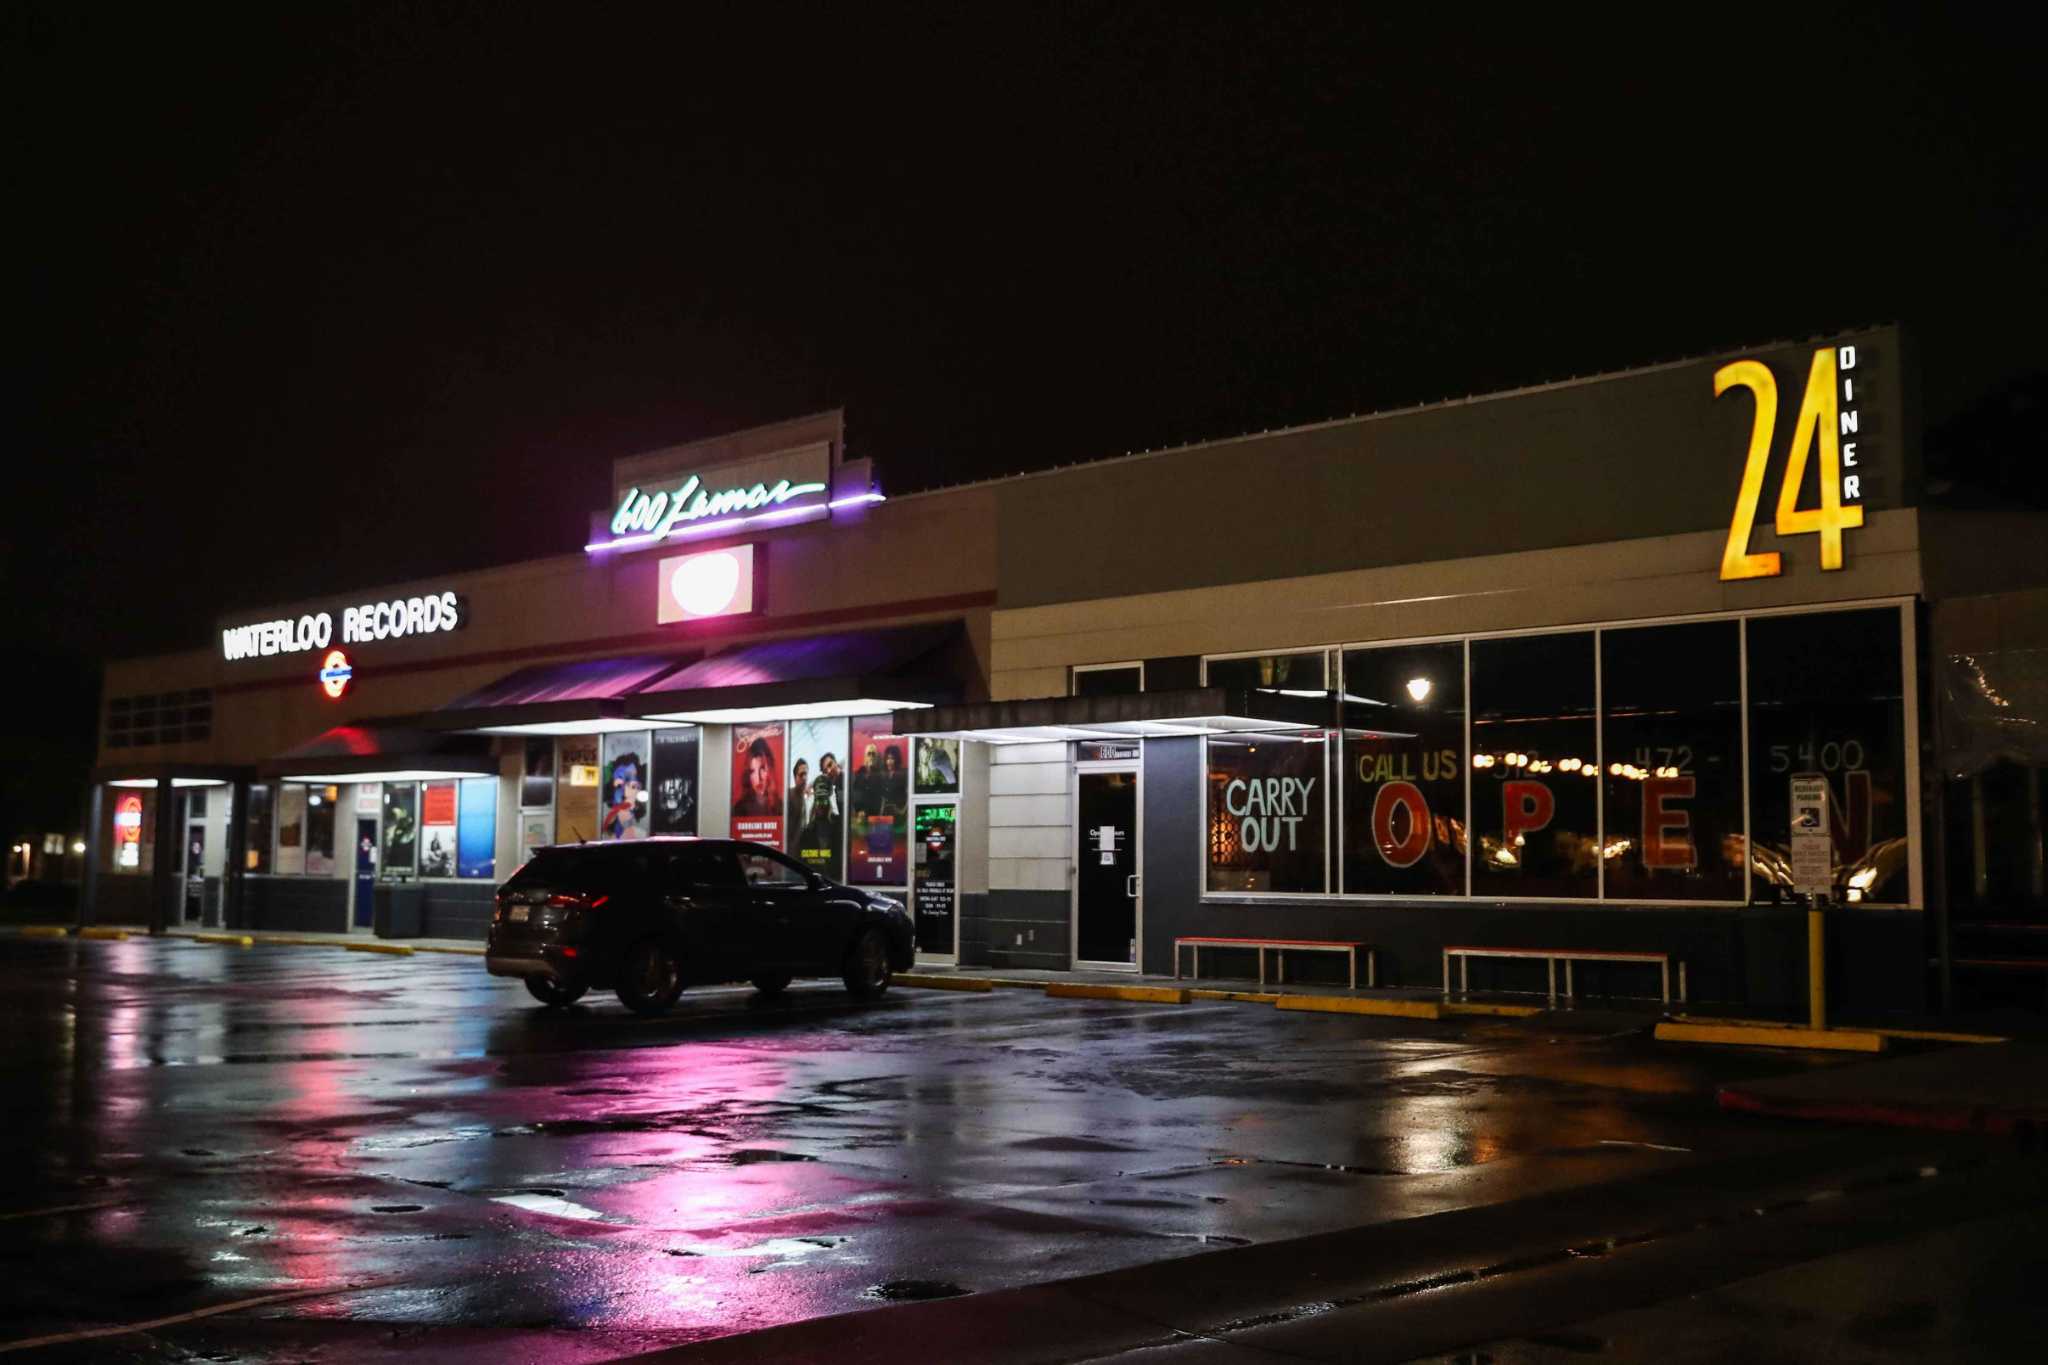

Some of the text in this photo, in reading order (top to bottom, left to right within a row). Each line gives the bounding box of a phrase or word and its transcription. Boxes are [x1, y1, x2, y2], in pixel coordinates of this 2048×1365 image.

[1839, 345, 1861, 500] DINER
[1713, 346, 1864, 581] 24
[610, 475, 826, 540] 600 Lamar
[222, 592, 458, 660] WATERLOO RECORDS
[1359, 753, 1416, 783] CALL
[1422, 749, 1457, 781] US
[1769, 740, 1864, 773] 5400
[1226, 776, 1316, 817] CARRY
[1241, 816, 1304, 853] OUT
